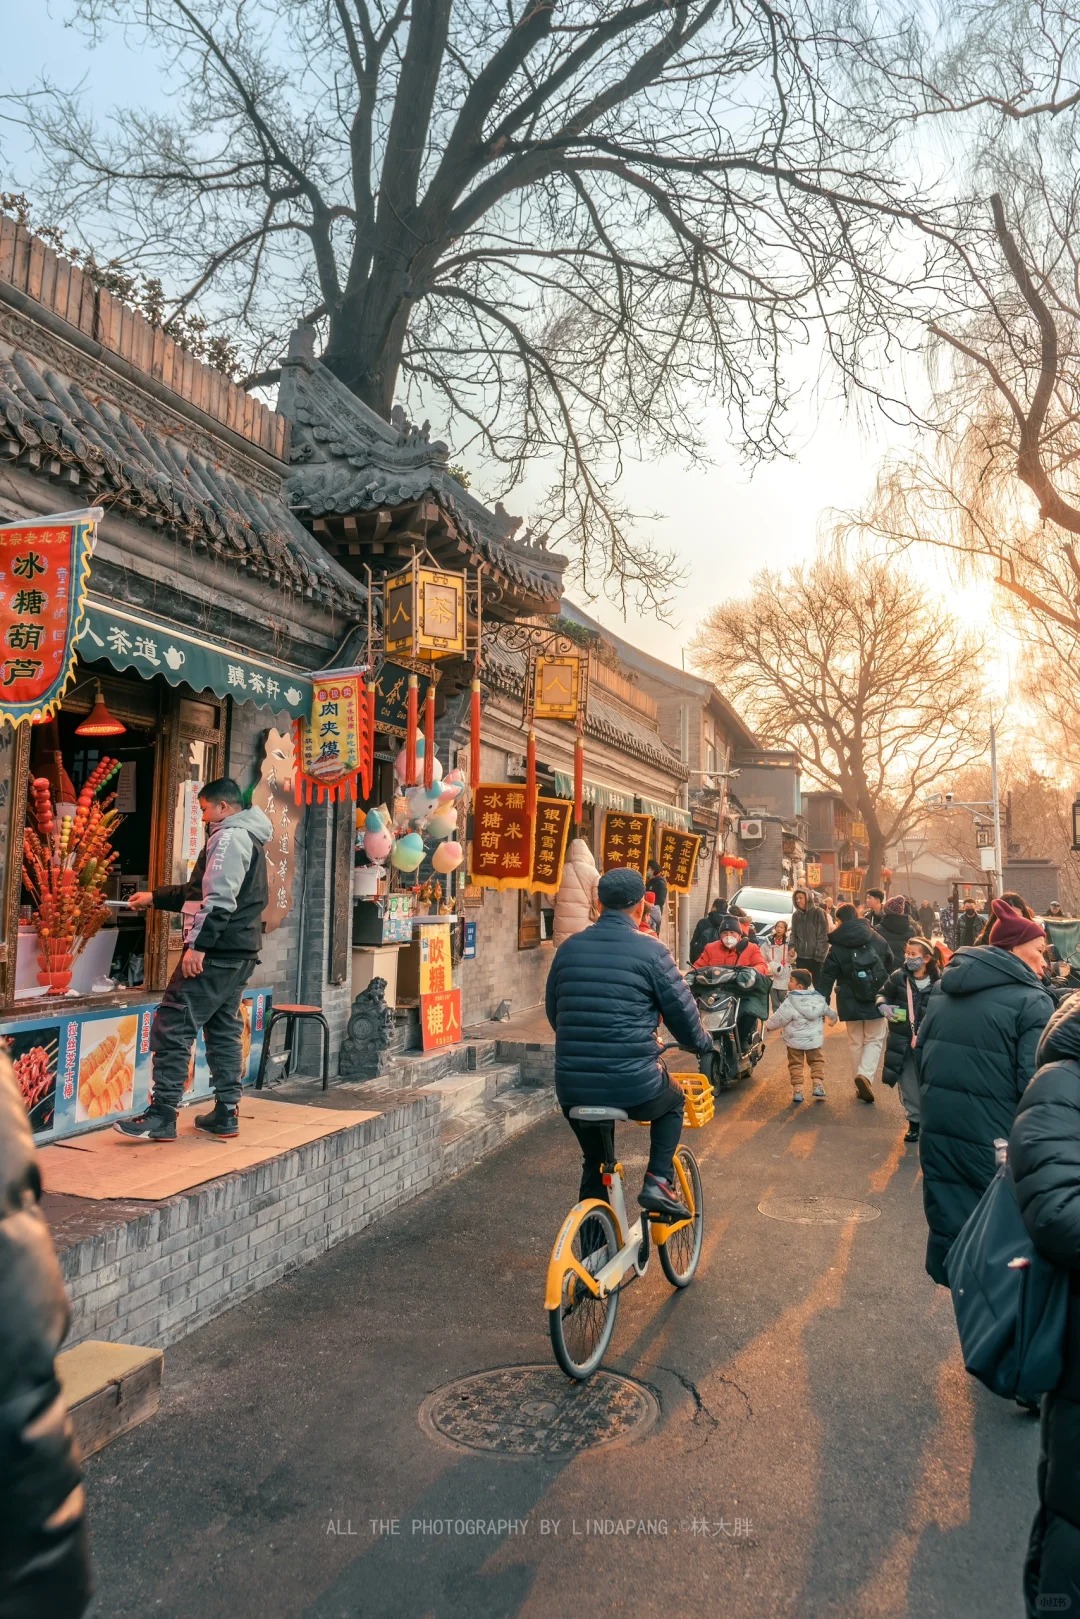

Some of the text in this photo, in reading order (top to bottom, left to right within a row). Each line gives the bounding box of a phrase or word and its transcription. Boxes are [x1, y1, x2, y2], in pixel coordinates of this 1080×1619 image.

[3, 552, 45, 686] 冰糖葫芦
[392, 602, 410, 624] 人
[427, 597, 454, 624] 茶
[227, 664, 281, 700] 聽茶軒
[545, 677, 569, 692] 人
[319, 702, 340, 757] 肉夹馍
[480, 793, 503, 867] 冰糖葫芦
[501, 792, 525, 868] 糯米糕
[537, 808, 560, 876] 银耳雪梨汤
[607, 818, 626, 862] 关东煮
[626, 820, 643, 870] 台湾烤肠
[427, 1002, 458, 1036] 糖人
[63, 1021, 78, 1099] 拉丝芝士棒
